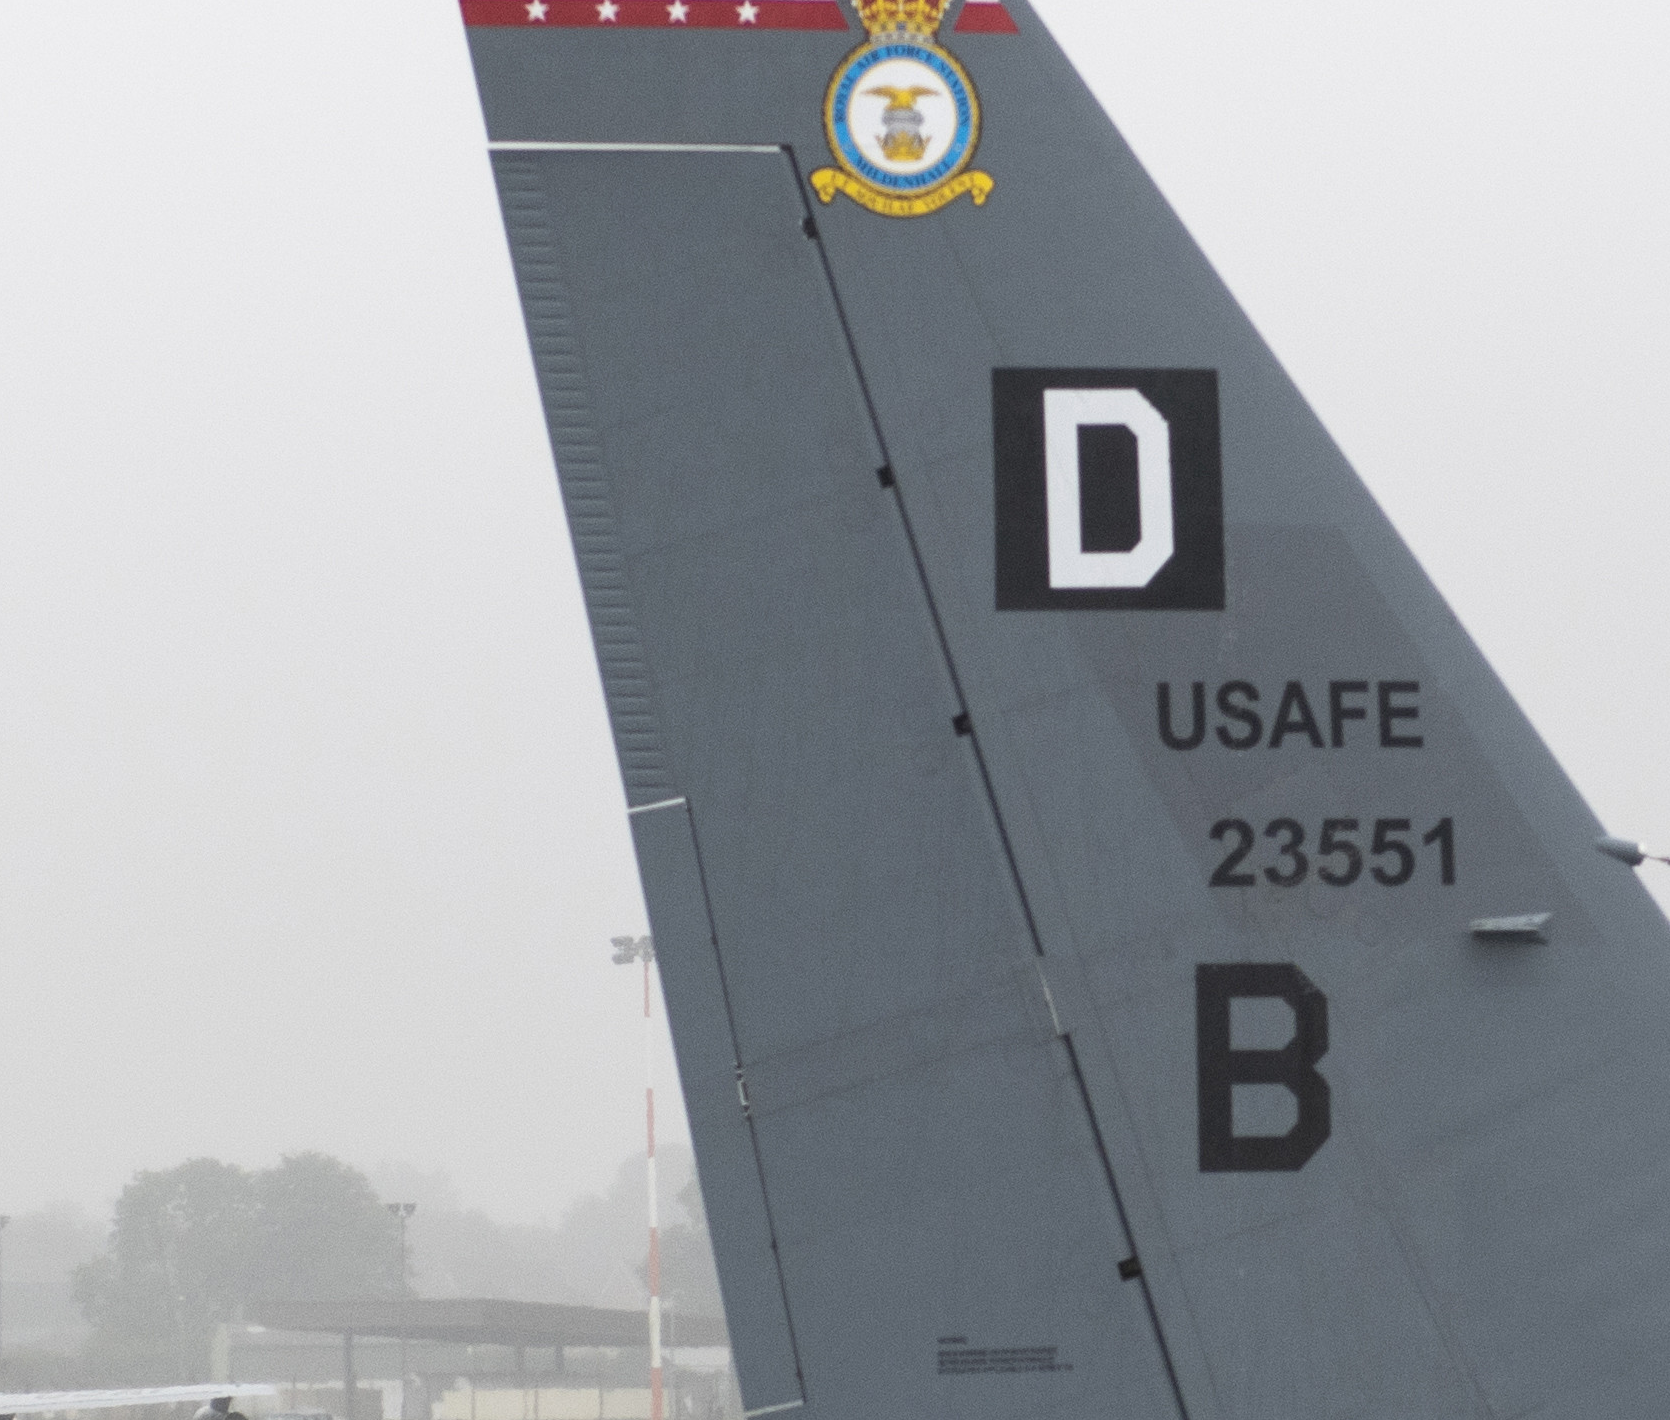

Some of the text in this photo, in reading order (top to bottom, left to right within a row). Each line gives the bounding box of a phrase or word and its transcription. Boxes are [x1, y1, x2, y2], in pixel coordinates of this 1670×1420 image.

[856, 50, 880, 70] AIR
[887, 45, 932, 62] FORCE
[939, 63, 970, 126] STATION
[855, 155, 951, 188] MILDENHALL
[1043, 388, 1175, 589] D
[1157, 681, 1424, 750] USAFE
[1208, 818, 1457, 887] 23551
[1196, 963, 1331, 1173] B
